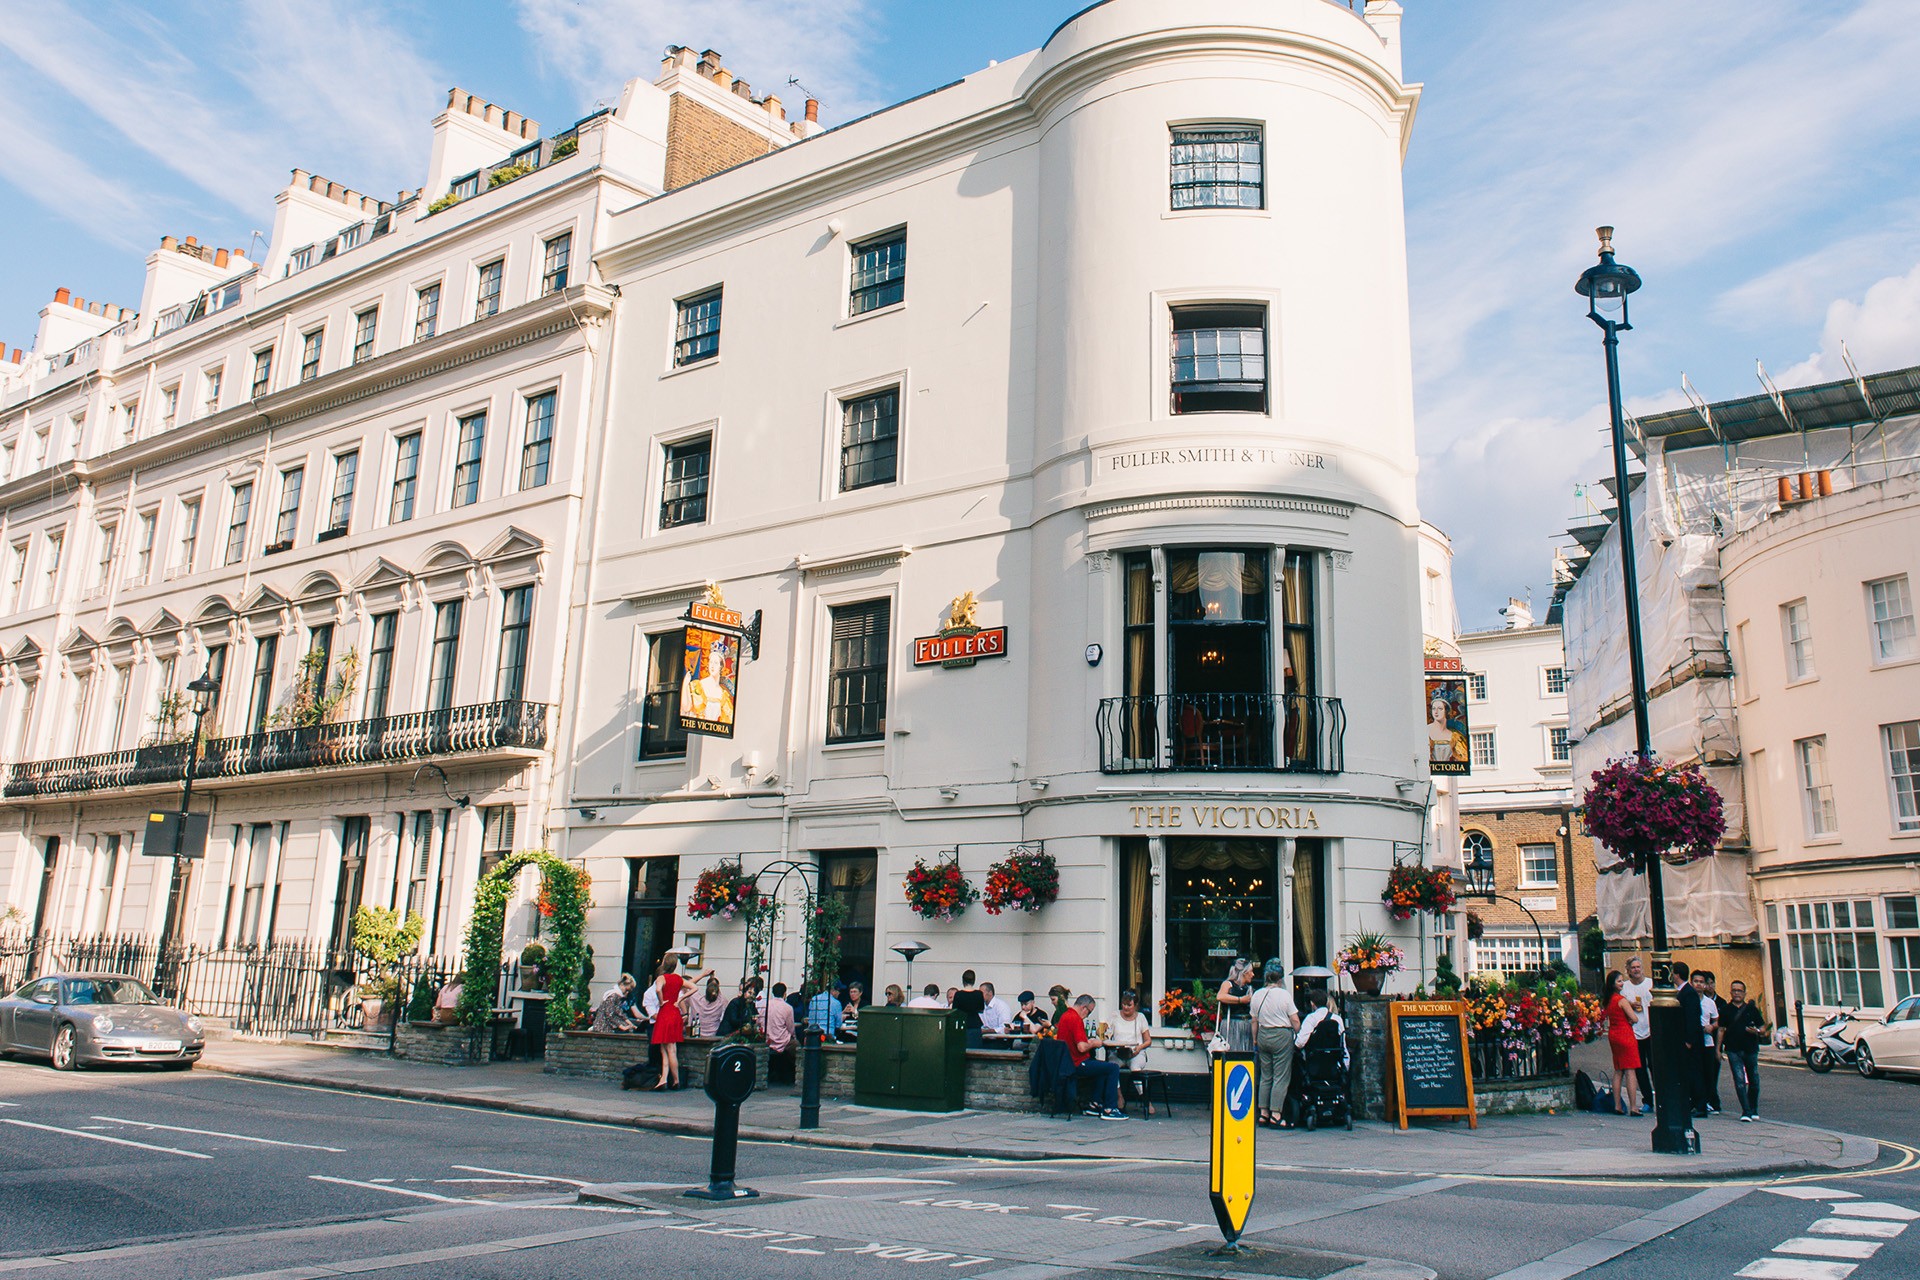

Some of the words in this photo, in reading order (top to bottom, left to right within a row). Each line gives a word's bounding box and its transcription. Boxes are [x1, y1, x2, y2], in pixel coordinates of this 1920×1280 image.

[1178, 449, 1235, 463] SMITH
[1241, 450, 1252, 463] &
[695, 605, 739, 624] FULLER'S
[919, 632, 998, 659] FULLER'S
[1424, 660, 1458, 669] LER'S
[681, 718, 696, 729] THE
[697, 721, 730, 733] VICTORIA
[1129, 805, 1182, 828] THE
[1191, 805, 1320, 830] VICTORIA
[1402, 1004, 1417, 1012] THE
[1418, 1004, 1453, 1012] VICTORIA
[734, 1060, 742, 1072] 2
[899, 1198, 1030, 1213] LOOK
[1061, 1212, 1218, 1232] LEFT
[662, 1222, 816, 1243] LEFT
[833, 1242, 995, 1268] LOOK
